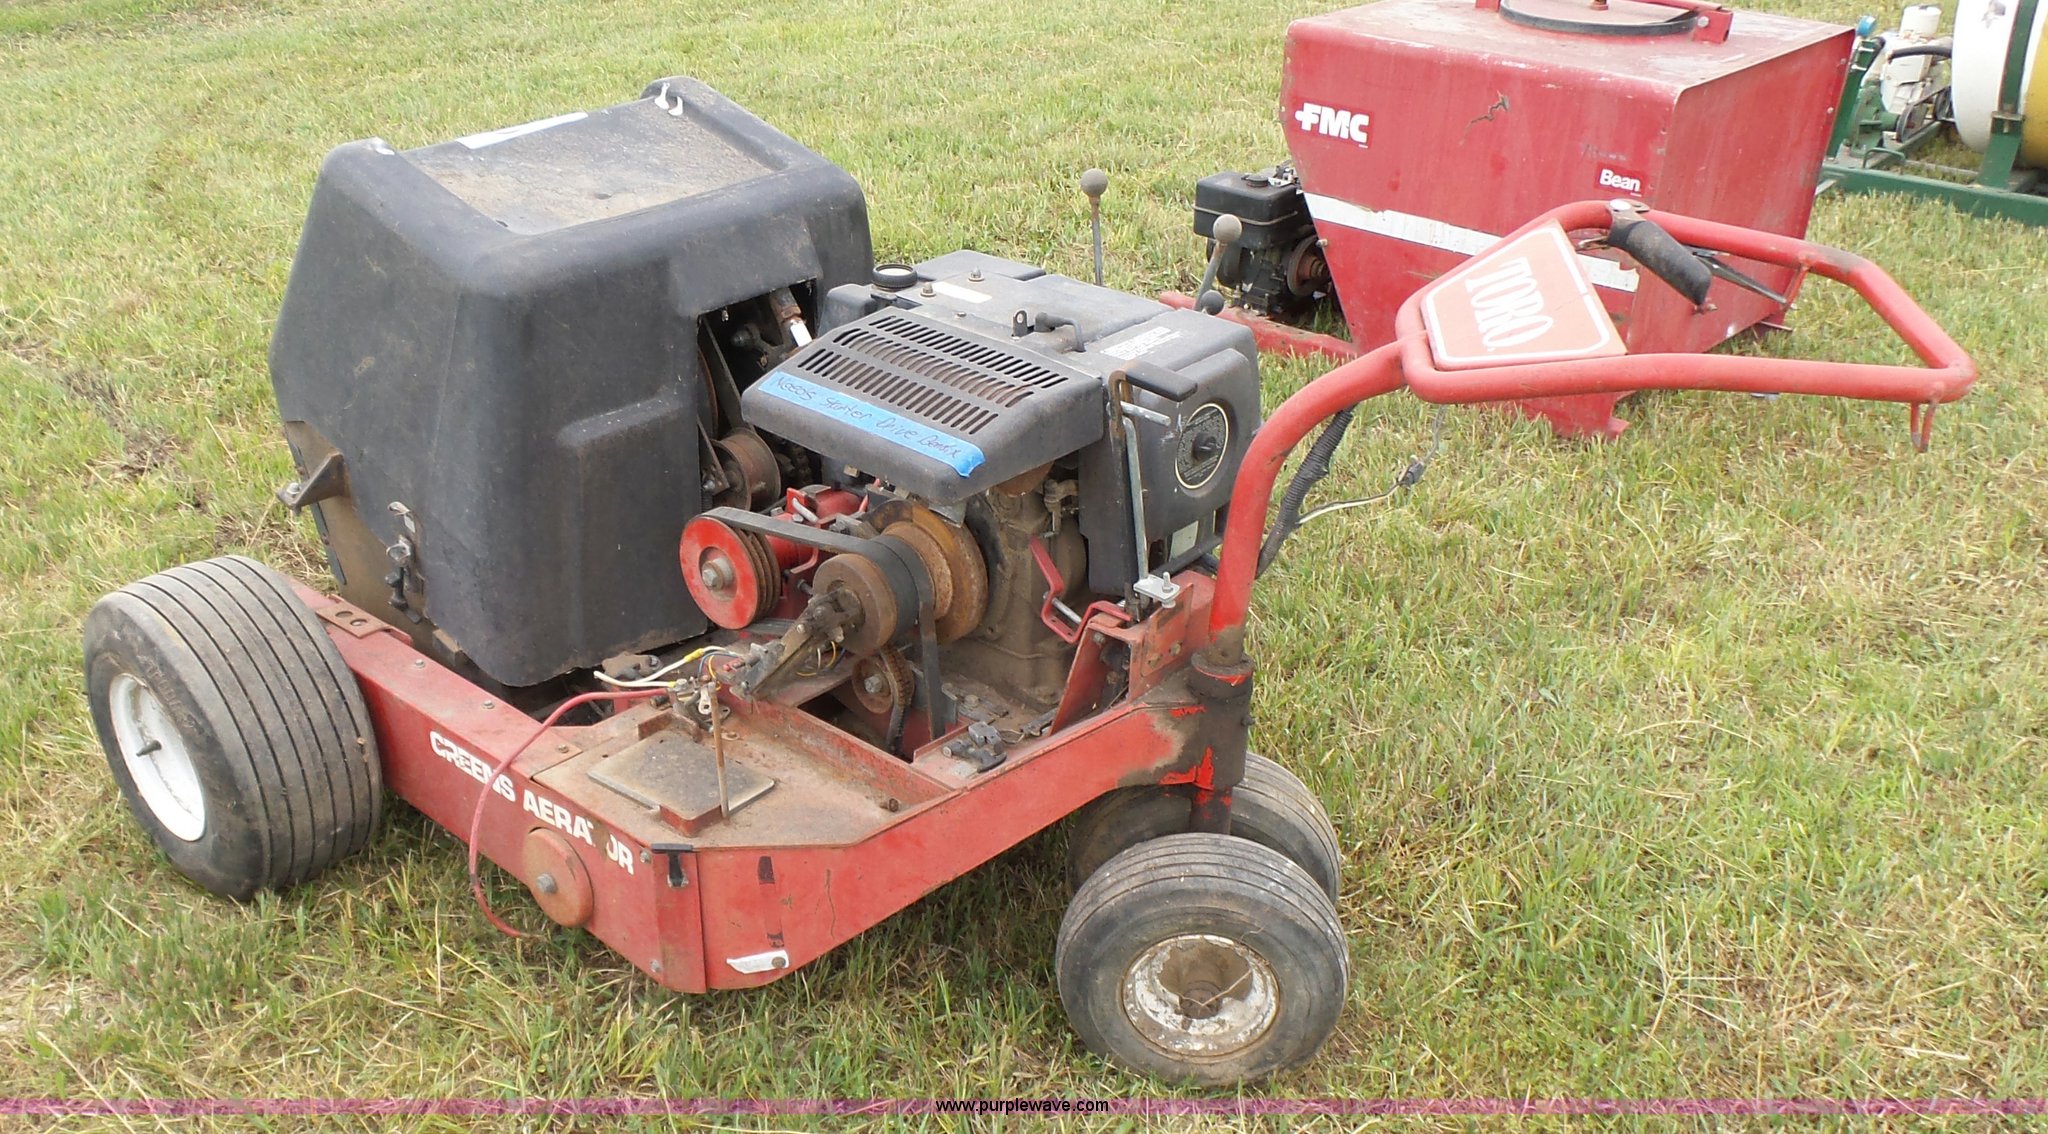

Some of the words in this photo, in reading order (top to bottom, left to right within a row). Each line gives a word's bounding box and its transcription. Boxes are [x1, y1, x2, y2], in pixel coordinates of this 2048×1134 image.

[1295, 102, 1370, 143] FMC
[1599, 168, 1641, 192] Bean
[1464, 256, 1553, 348] TORO
[876, 417, 918, 440] Drive
[429, 731, 516, 803] GREENS
[523, 789, 635, 875] AERAOR
